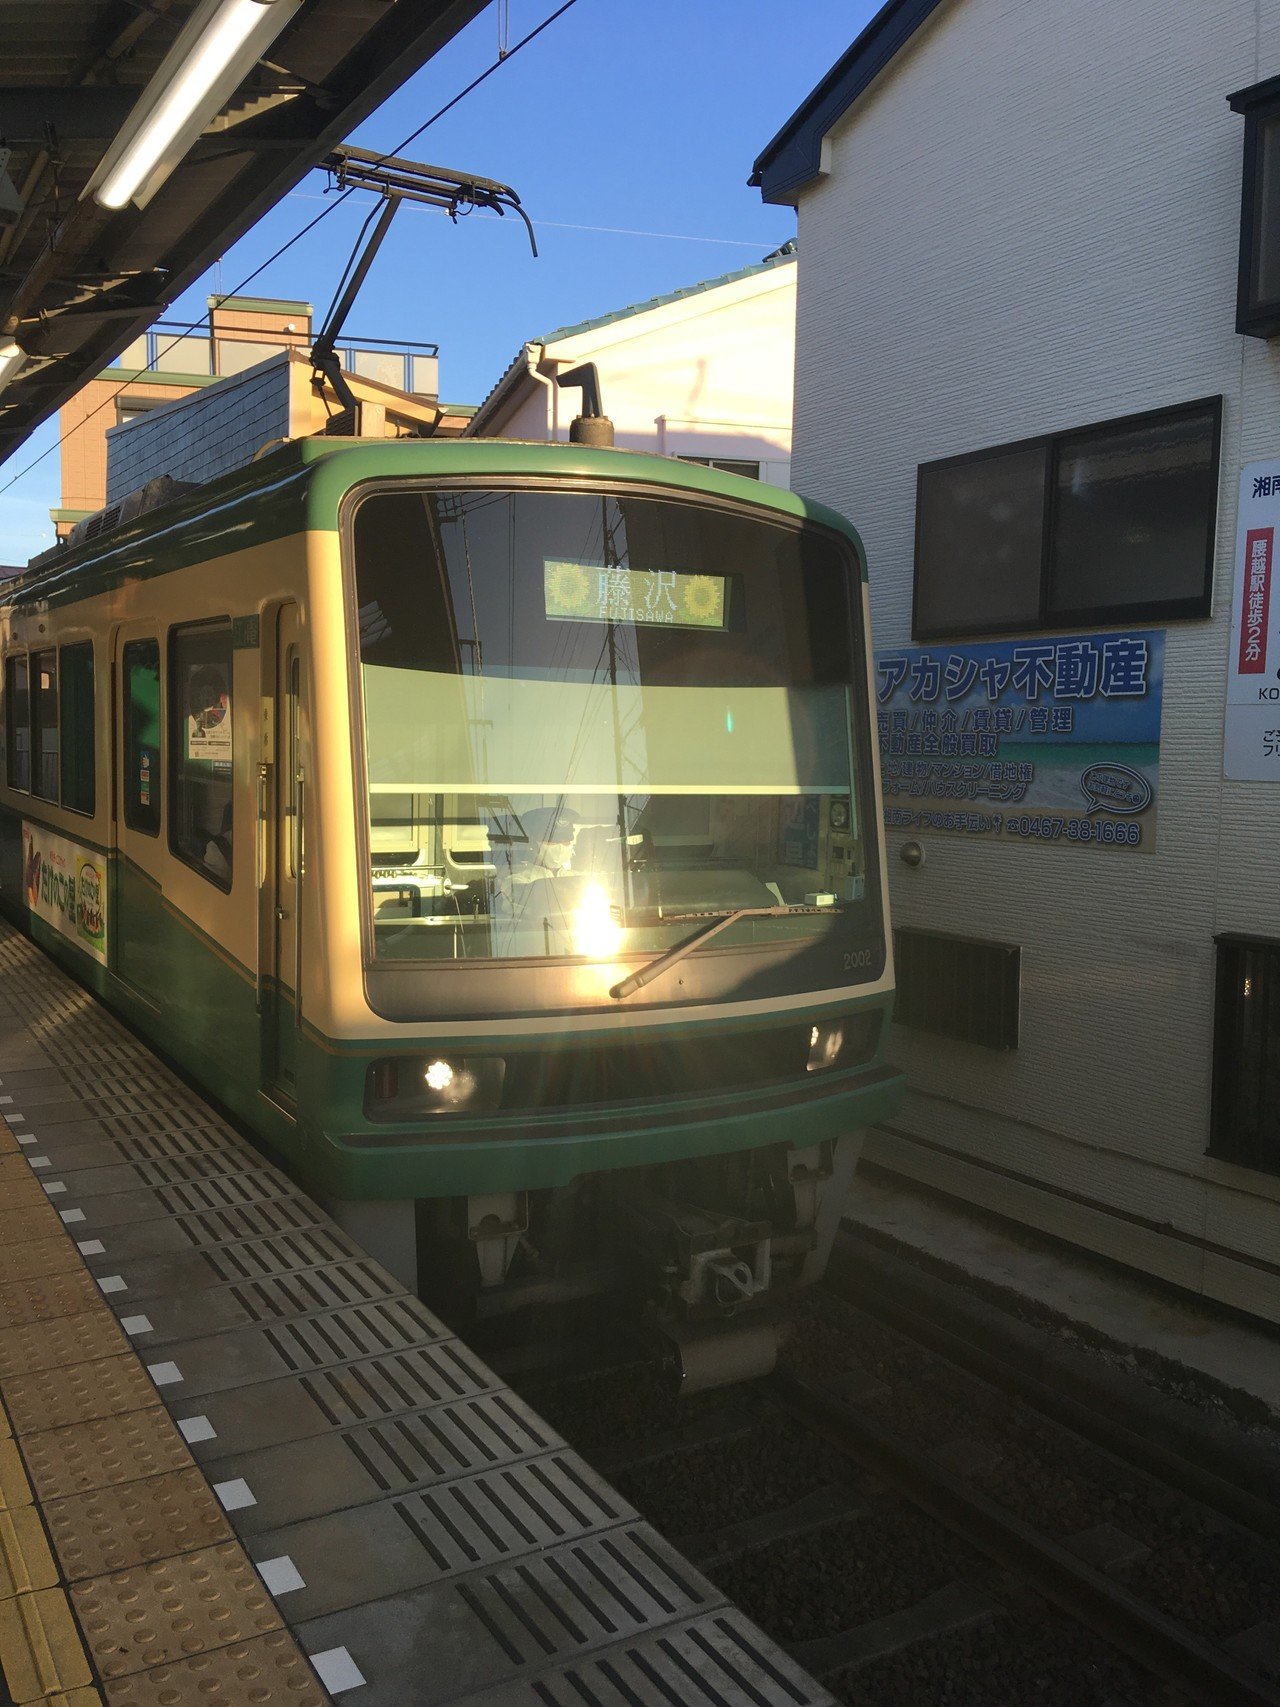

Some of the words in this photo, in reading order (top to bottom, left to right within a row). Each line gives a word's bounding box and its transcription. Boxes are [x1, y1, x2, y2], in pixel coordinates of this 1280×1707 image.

[595, 564, 677, 610] 藤沢
[1245, 539, 1268, 661] 腰越駅徒歩2分
[600, 606, 674, 623] FUJISAWA
[1020, 816, 1140, 845] 0467-38-1666
[843, 949, 873, 970] 2002
